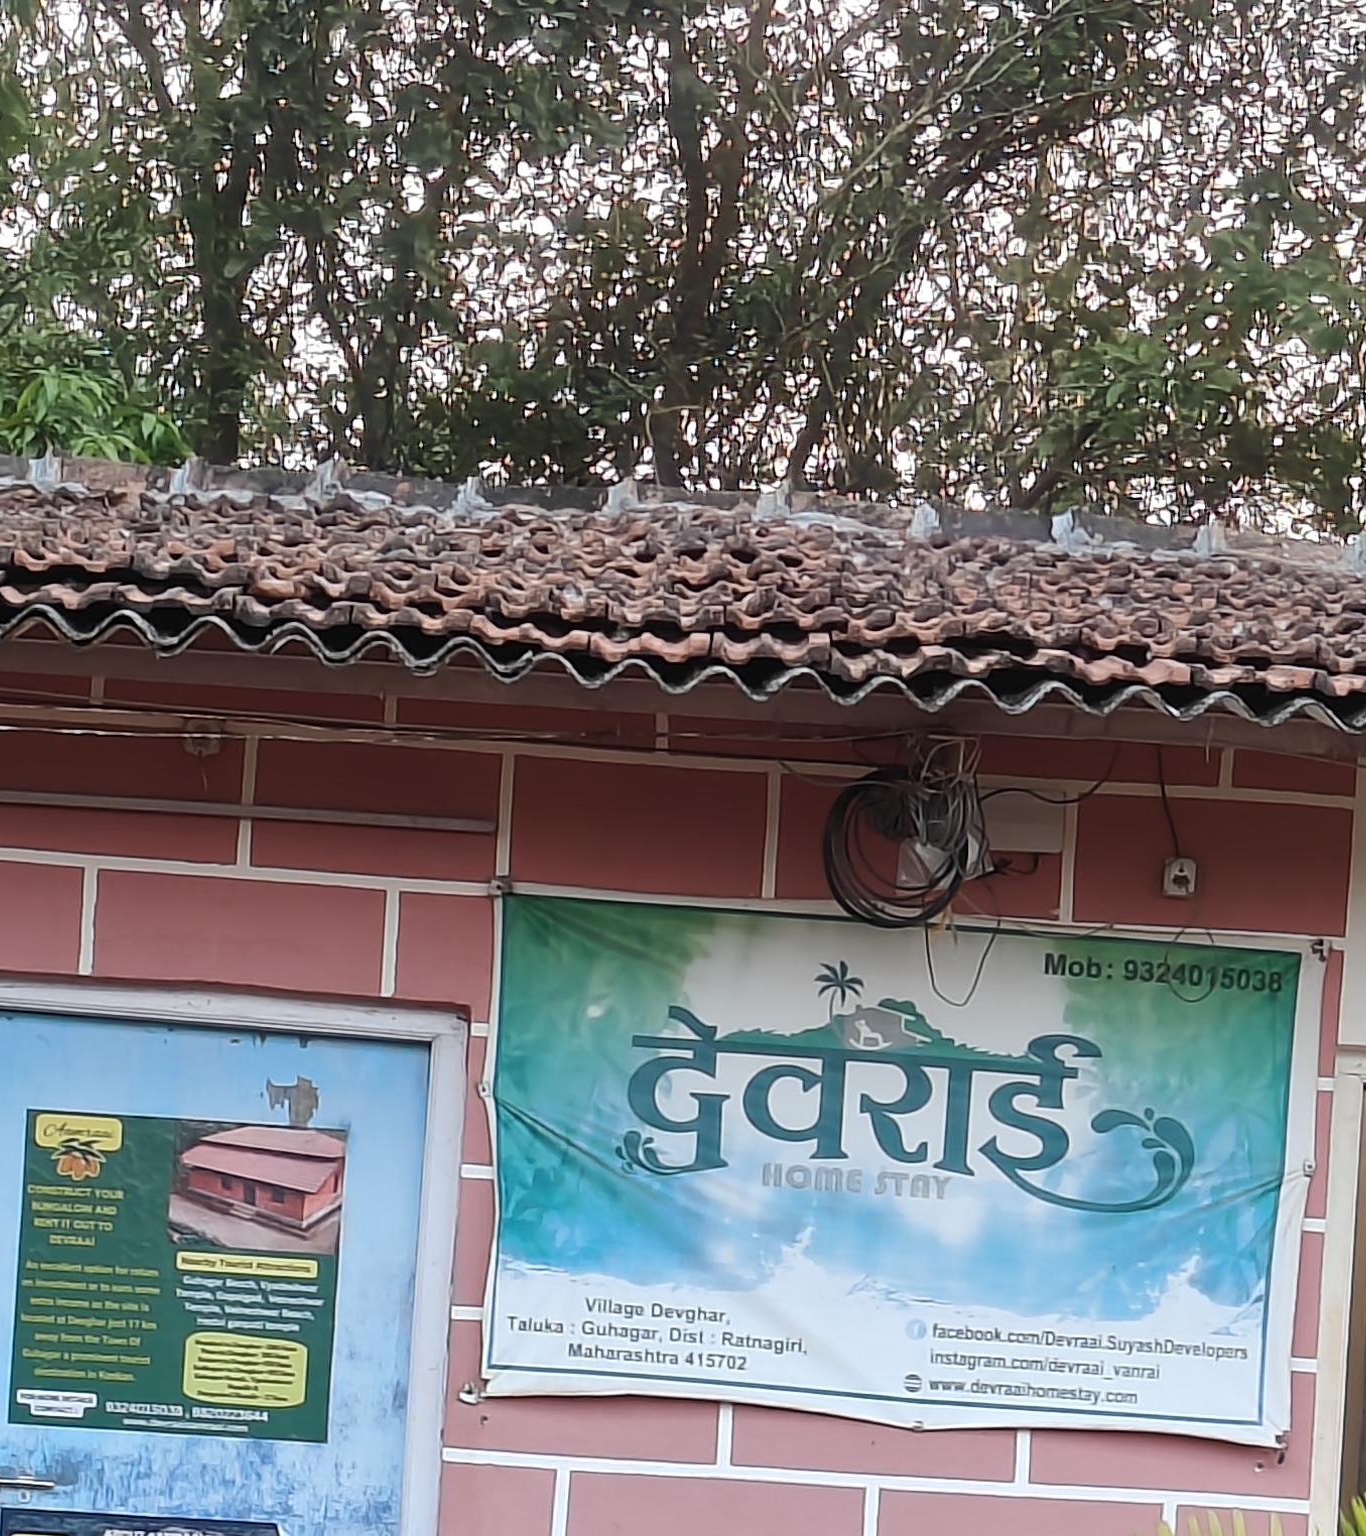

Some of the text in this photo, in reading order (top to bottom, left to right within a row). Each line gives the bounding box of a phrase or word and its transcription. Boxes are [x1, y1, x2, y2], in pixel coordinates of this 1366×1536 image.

[1044, 952, 1283, 993] Mob: 9324015038
[616, 1004, 1195, 1213] देवराई
[762, 1161, 953, 1200] HOME STAY
[585, 1297, 731, 1325] Village Devghar,
[507, 1315, 564, 1335] Taluka
[581, 1320, 663, 1343] Guhagar,
[669, 1328, 704, 1345] Dist
[721, 1331, 808, 1356] Ratnagiri,
[567, 1343, 748, 1371] Maharashtra 415702
